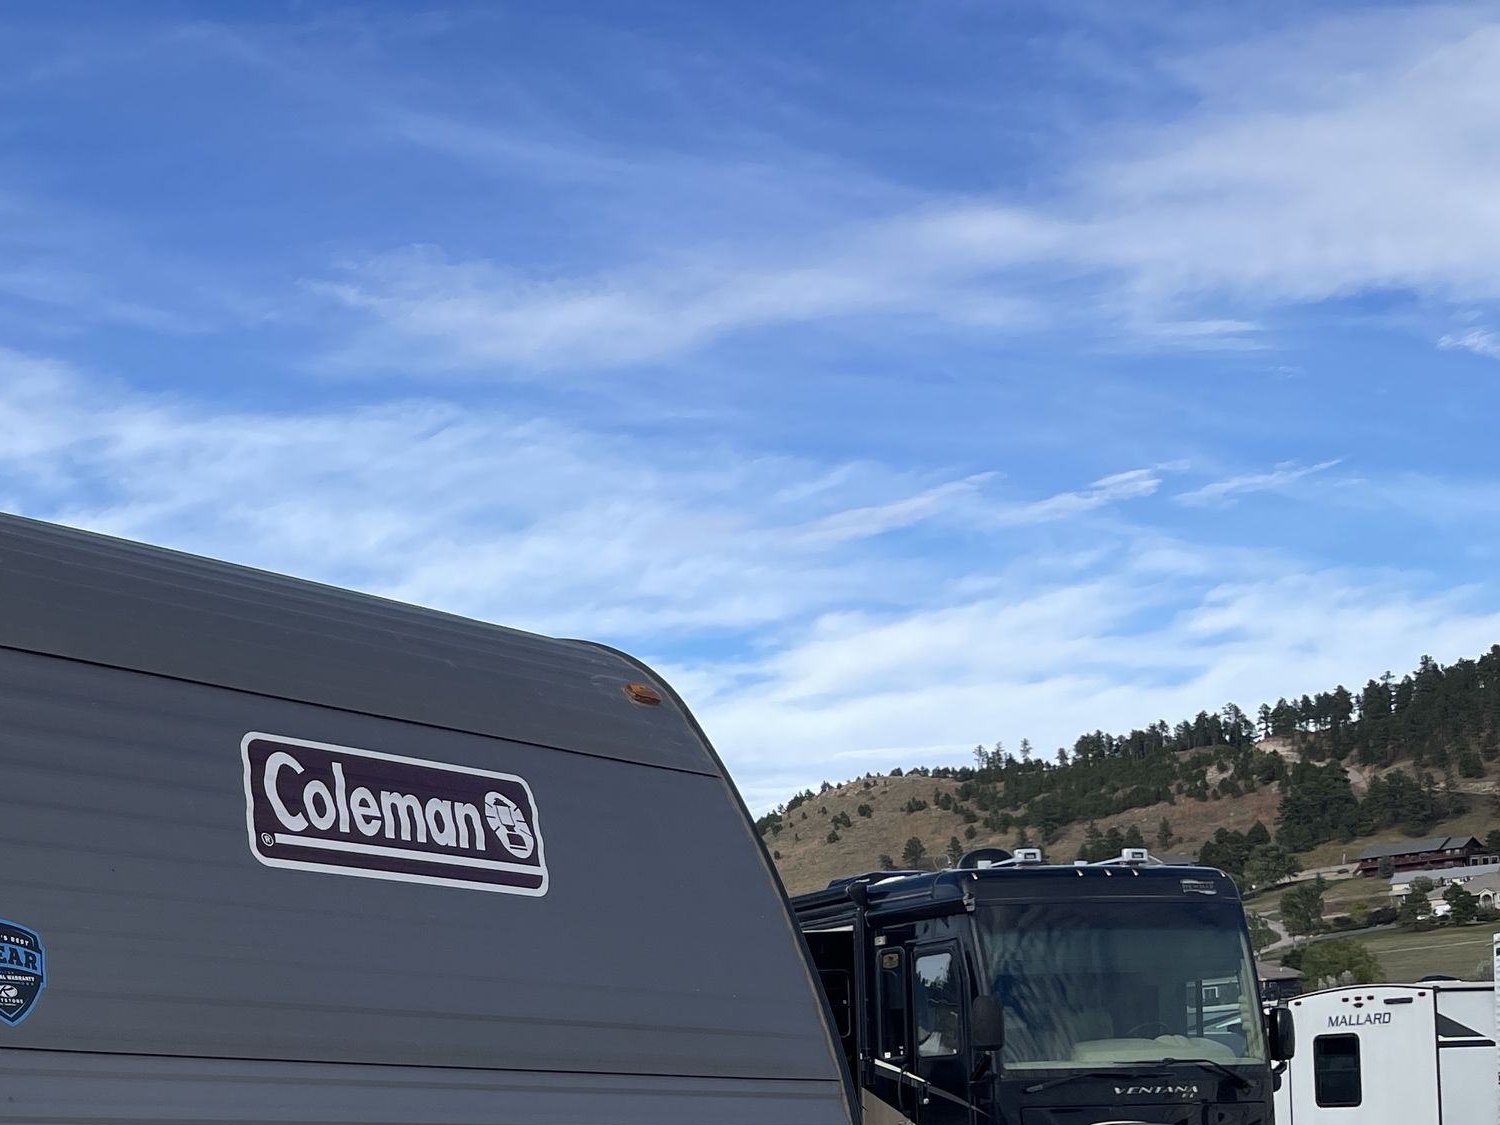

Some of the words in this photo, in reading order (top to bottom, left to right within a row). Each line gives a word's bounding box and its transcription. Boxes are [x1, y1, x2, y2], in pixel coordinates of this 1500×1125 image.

[263, 751, 486, 851] Coleman
[10, 936, 29, 946] BEST
[6, 974, 35, 982] WARRANTY
[1328, 1012, 1392, 1027] MALLARD
[1114, 1086, 1198, 1094] VENTANA
